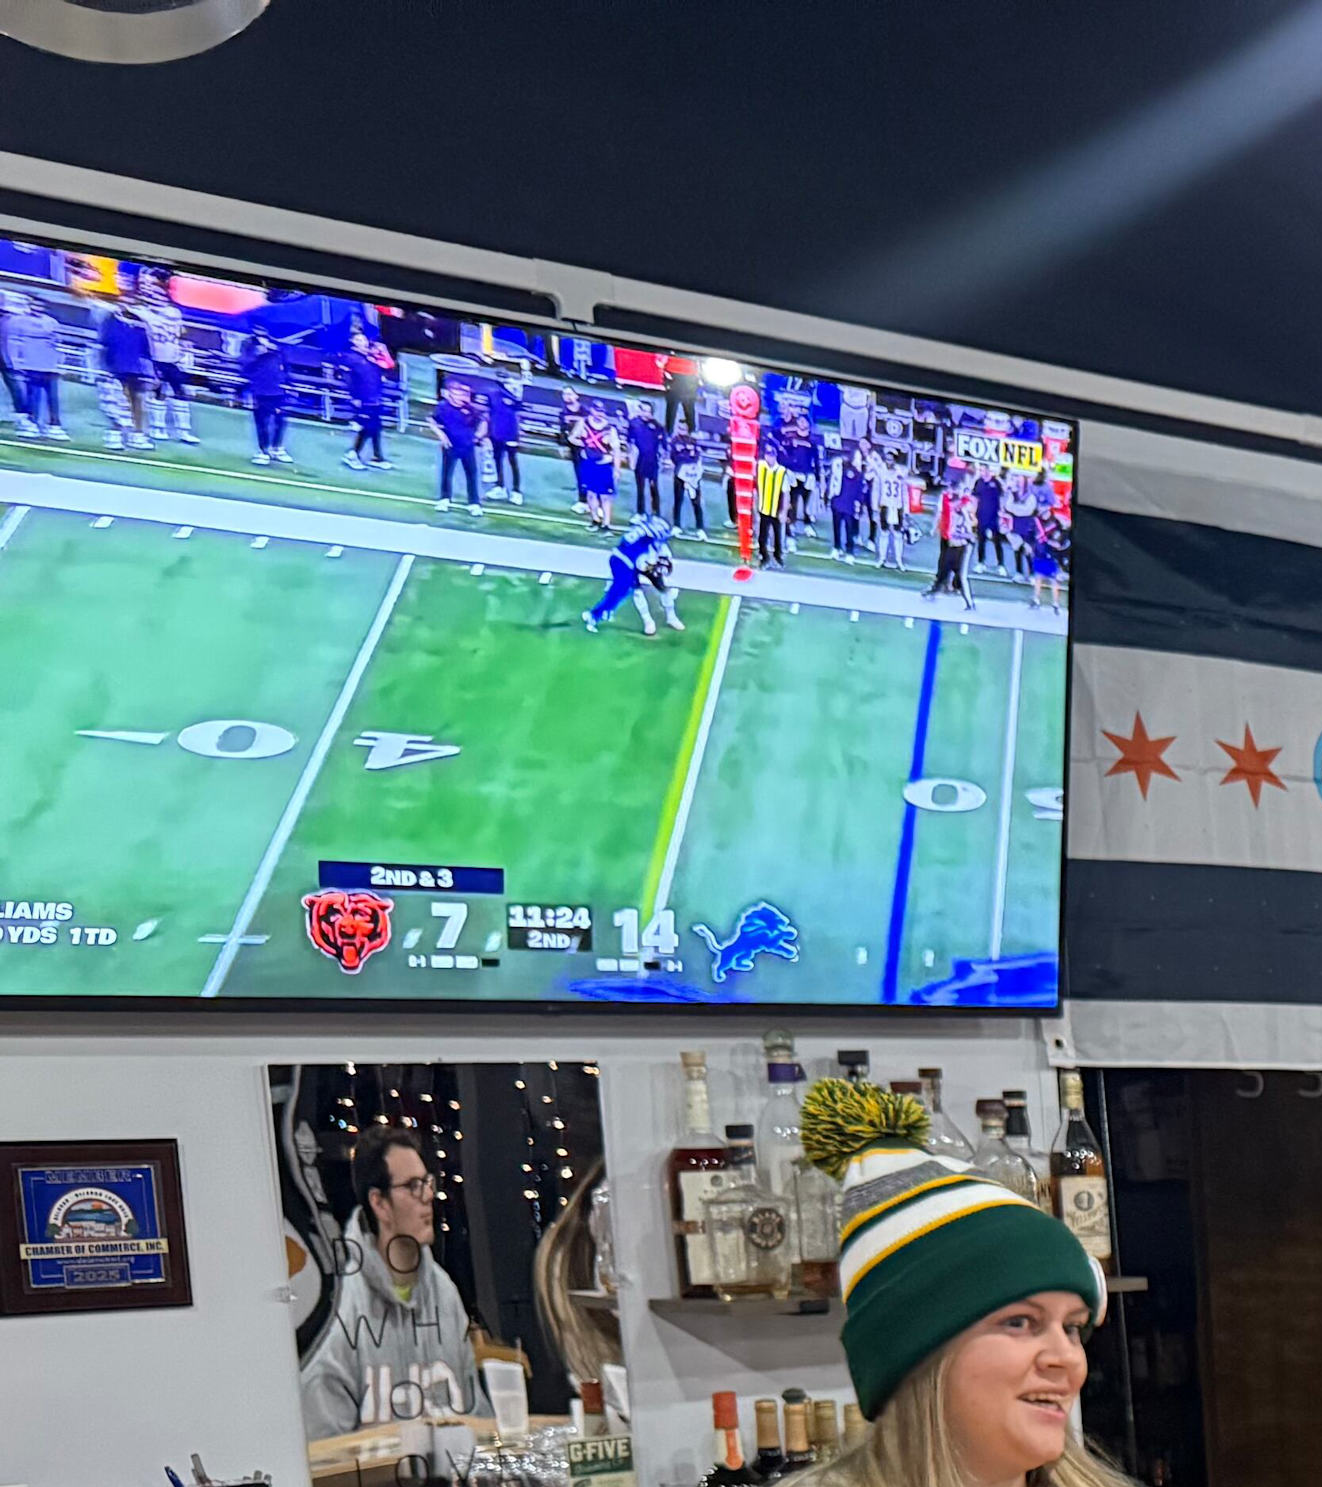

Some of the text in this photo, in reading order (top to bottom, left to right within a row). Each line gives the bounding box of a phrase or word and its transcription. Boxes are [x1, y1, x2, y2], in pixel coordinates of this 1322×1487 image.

[957, 433, 1039, 467] FOX NFL
[370, 867, 454, 888] 2ND & 3
[0, 901, 74, 921] IAMS
[508, 905, 592, 930] 11:24
[8, 926, 58, 945] YDS
[431, 903, 468, 949] 7
[613, 907, 680, 955] 14
[527, 931, 570, 950] 2ND
[25, 1243, 69, 1257] CHAMBER
[75, 1244, 86, 1255] OF
